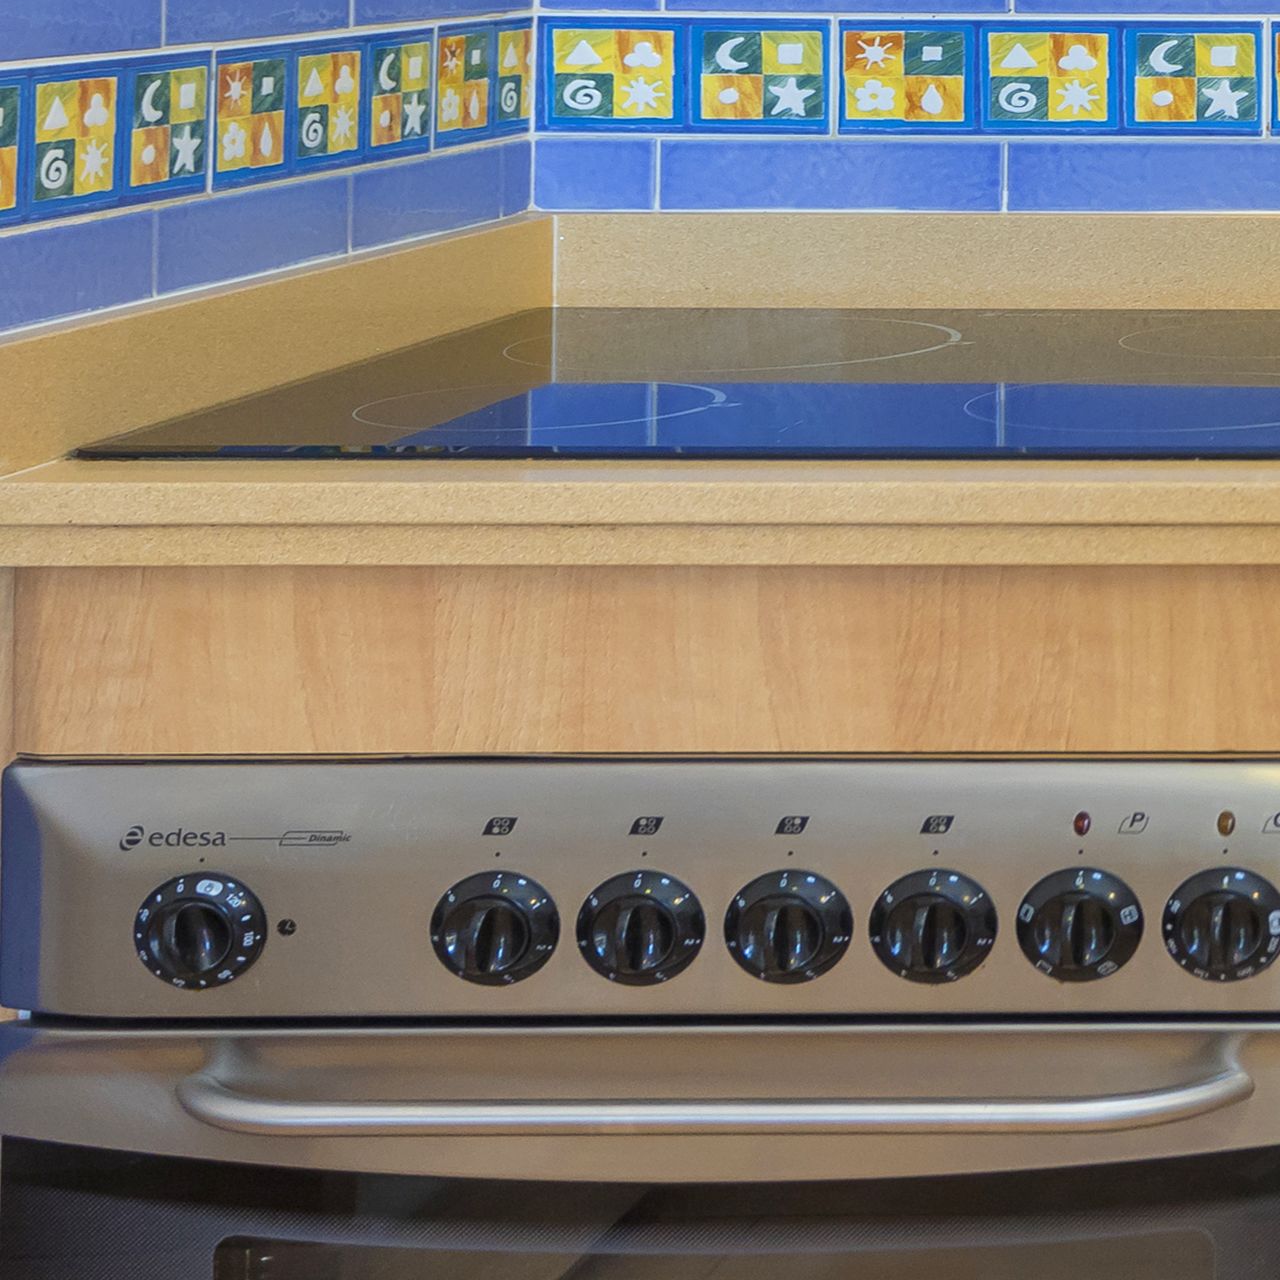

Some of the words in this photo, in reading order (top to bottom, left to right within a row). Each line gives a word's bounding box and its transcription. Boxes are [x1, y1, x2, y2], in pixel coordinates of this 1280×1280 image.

[1129, 812, 1146, 829] P
[148, 828, 227, 847] edesa
[308, 834, 352, 843] Dinamic
[225, 893, 242, 908] 120
[242, 930, 255, 947] 100
